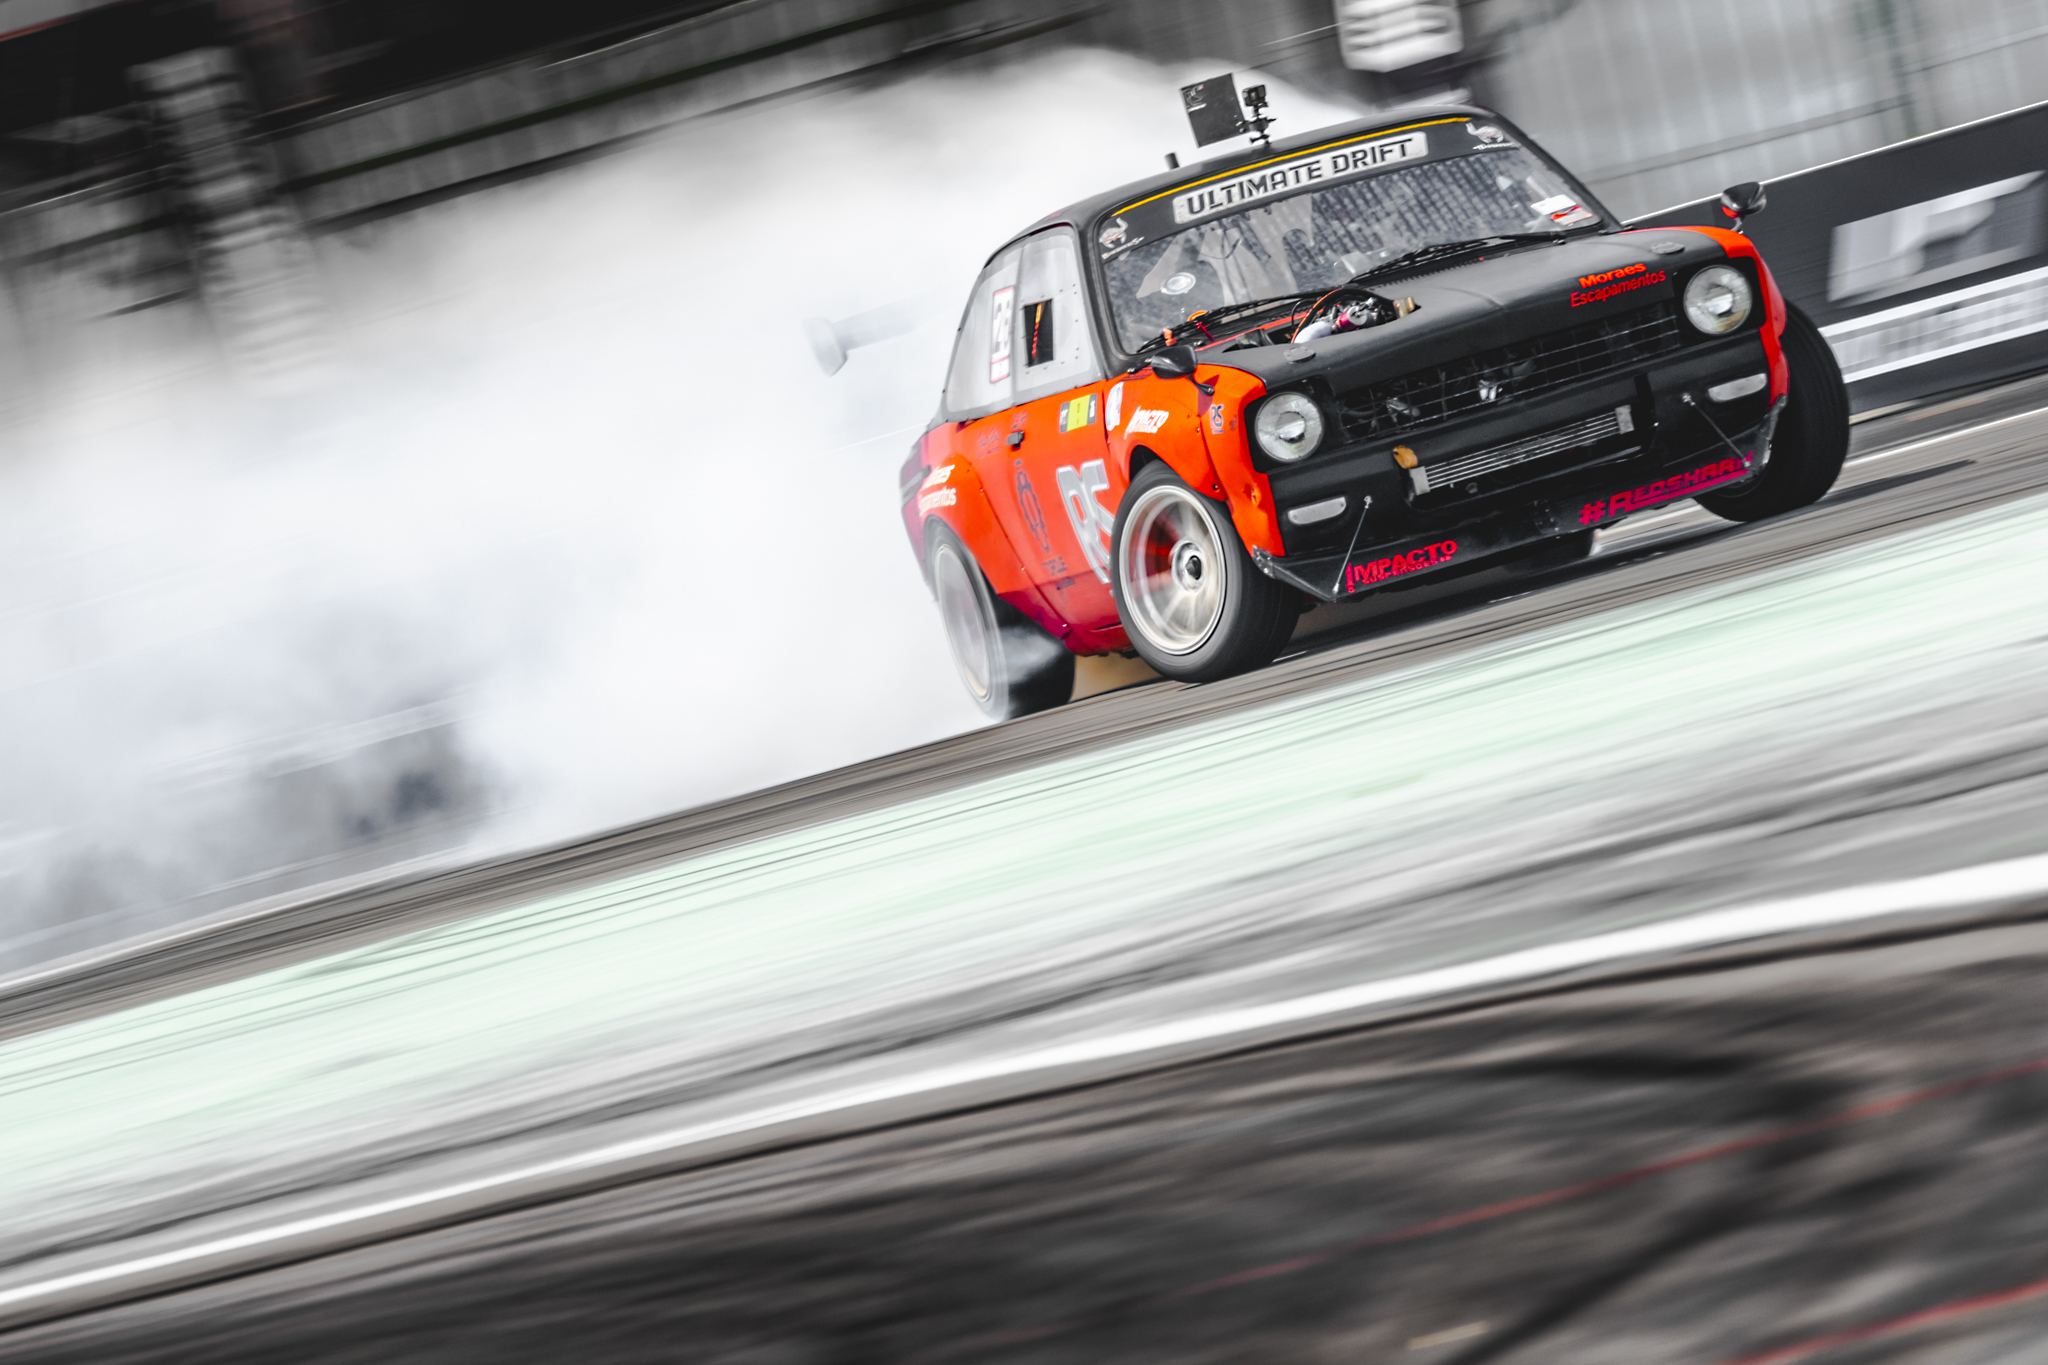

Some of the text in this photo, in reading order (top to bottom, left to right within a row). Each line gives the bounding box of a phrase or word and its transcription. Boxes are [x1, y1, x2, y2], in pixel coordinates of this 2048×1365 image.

[1187, 138, 1413, 216] ULTIMATE DRIFT
[1569, 269, 1667, 308] Escapamentos
[1579, 262, 1647, 289] Moraes
[1345, 539, 1458, 594] IMPACTO
